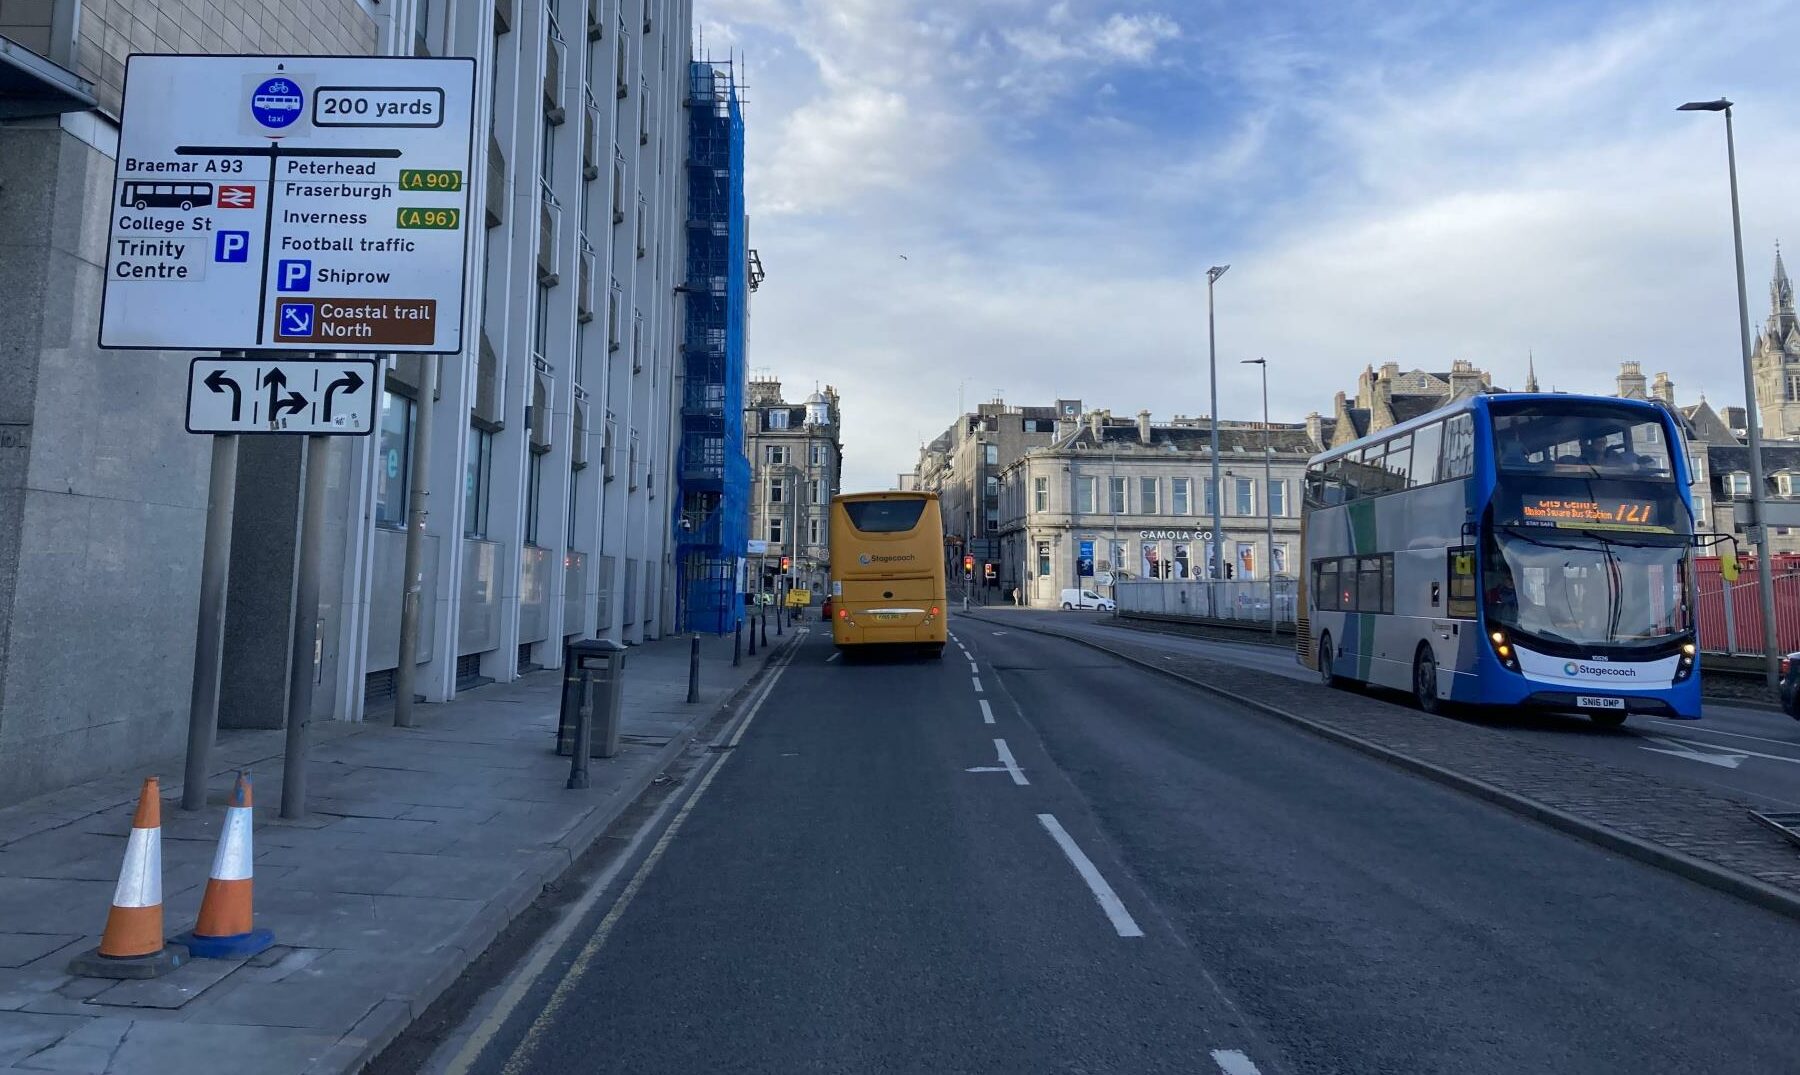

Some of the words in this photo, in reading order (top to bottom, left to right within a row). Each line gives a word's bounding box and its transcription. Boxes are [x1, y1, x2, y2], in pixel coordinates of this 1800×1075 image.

[324, 98, 368, 115] 200
[376, 99, 433, 117] yards
[267, 114, 285, 123] taxi
[125, 158, 199, 173] Braemar
[288, 161, 376, 175] Peterhead
[402, 172, 459, 189] (A90)
[286, 183, 392, 202] Fraserburgh
[118, 216, 185, 233] College
[192, 217, 212, 231] St
[284, 209, 368, 224] Inverness
[399, 211, 457, 228] (A96)
[117, 239, 185, 259] Trinity
[281, 236, 354, 252] Football
[359, 237, 416, 253] traffic
[115, 261, 189, 279] Centre
[317, 268, 391, 285] Shiprow
[320, 303, 388, 320] Coastal
[394, 305, 430, 320] trail
[321, 322, 373, 337] North
[1524, 506, 1546, 517] Union
[1139, 530, 1190, 540] GAMOLA
[871, 554, 915, 563] Stagecoach
[1579, 664, 1636, 677] Stagecoach
